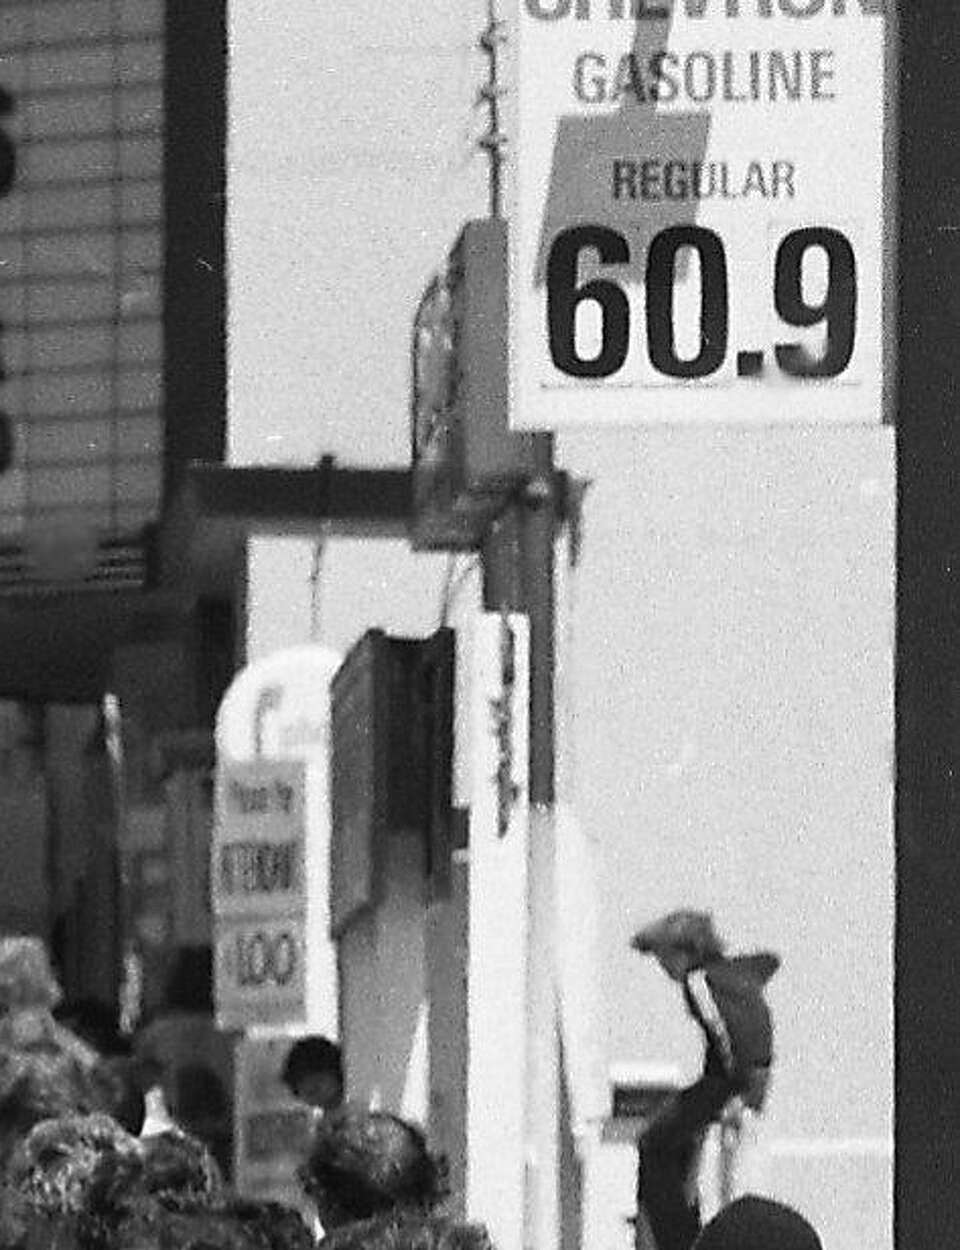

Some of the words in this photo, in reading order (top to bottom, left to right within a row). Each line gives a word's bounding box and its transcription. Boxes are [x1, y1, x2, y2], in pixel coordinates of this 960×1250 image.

[573, 50, 836, 104] GASOLINE
[612, 159, 797, 201] REGULAR
[546, 225, 859, 380] 60.9
